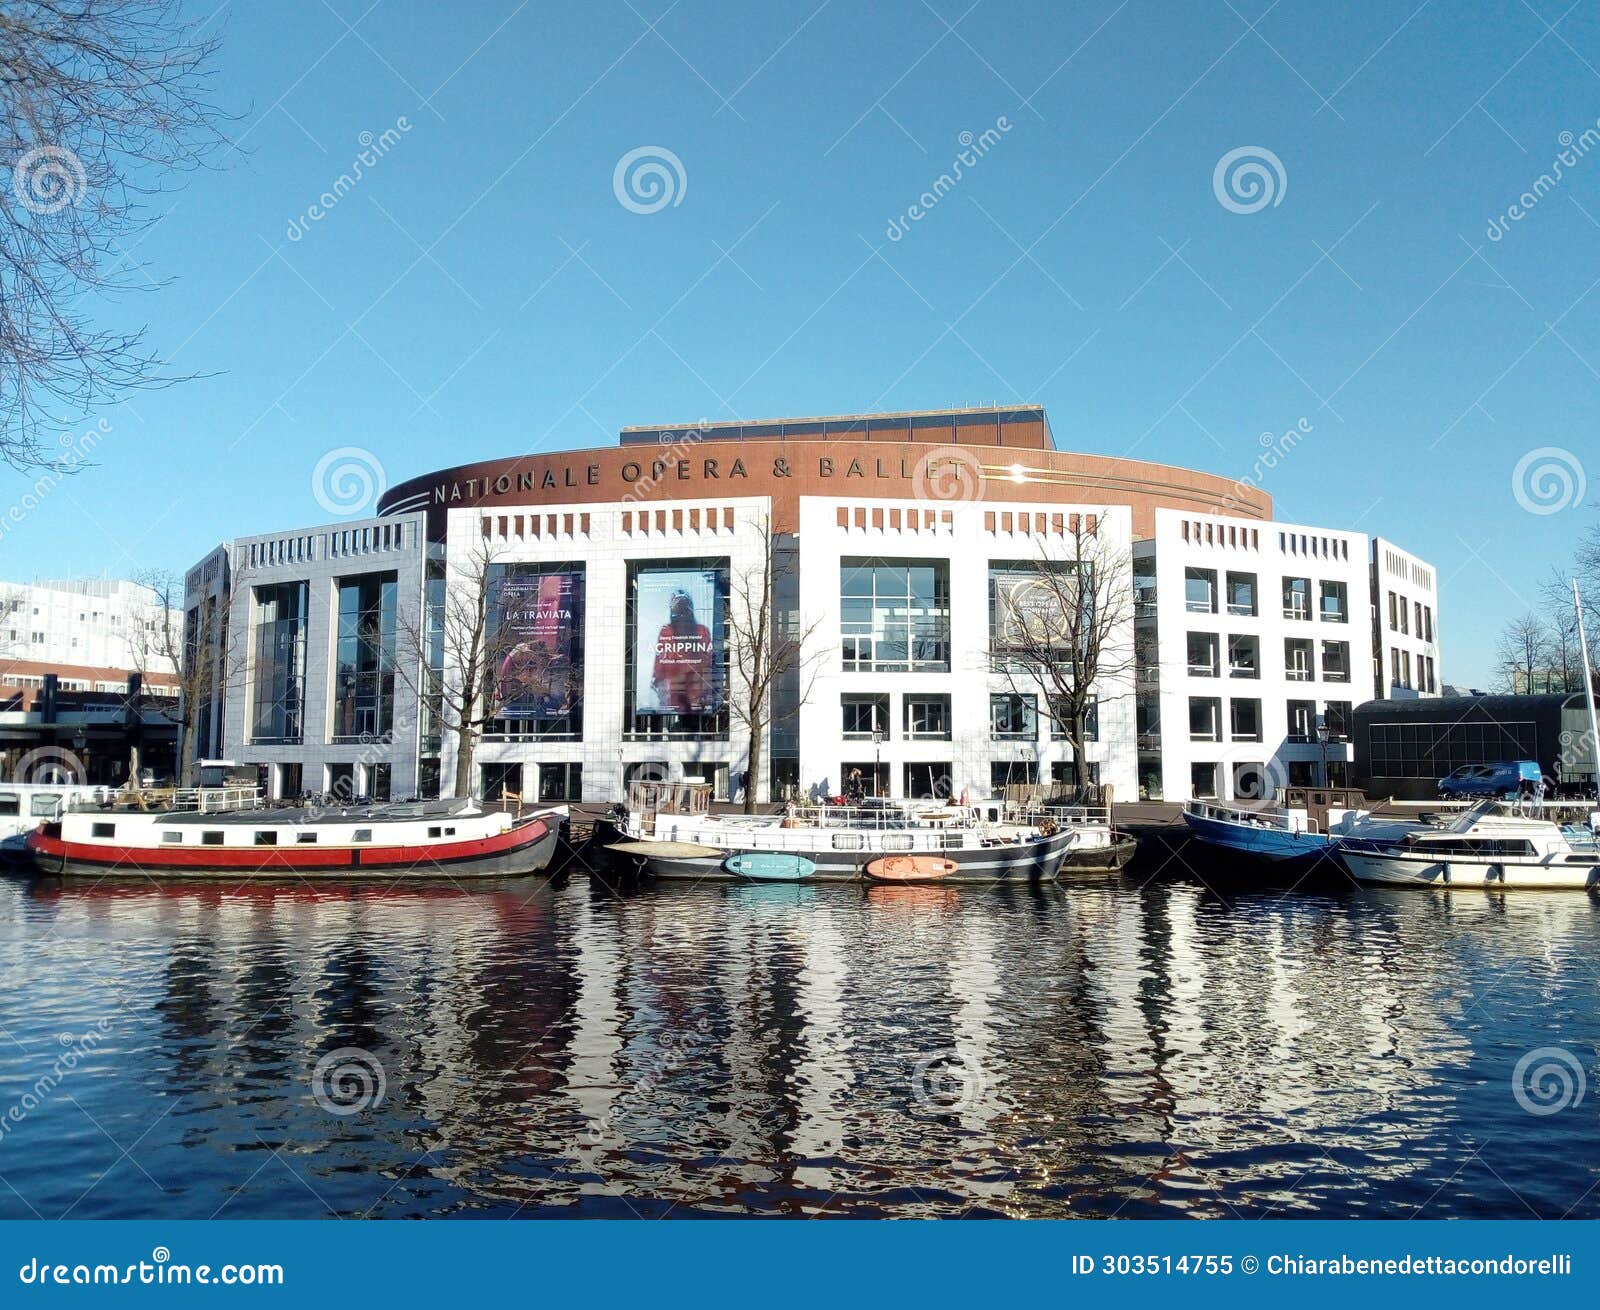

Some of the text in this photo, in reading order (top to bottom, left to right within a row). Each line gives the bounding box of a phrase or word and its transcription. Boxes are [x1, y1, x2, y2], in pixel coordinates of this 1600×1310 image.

[434, 457, 967, 504] NATIONALE OPERA & BALLET
[506, 609, 572, 620] LA TRAVIATA
